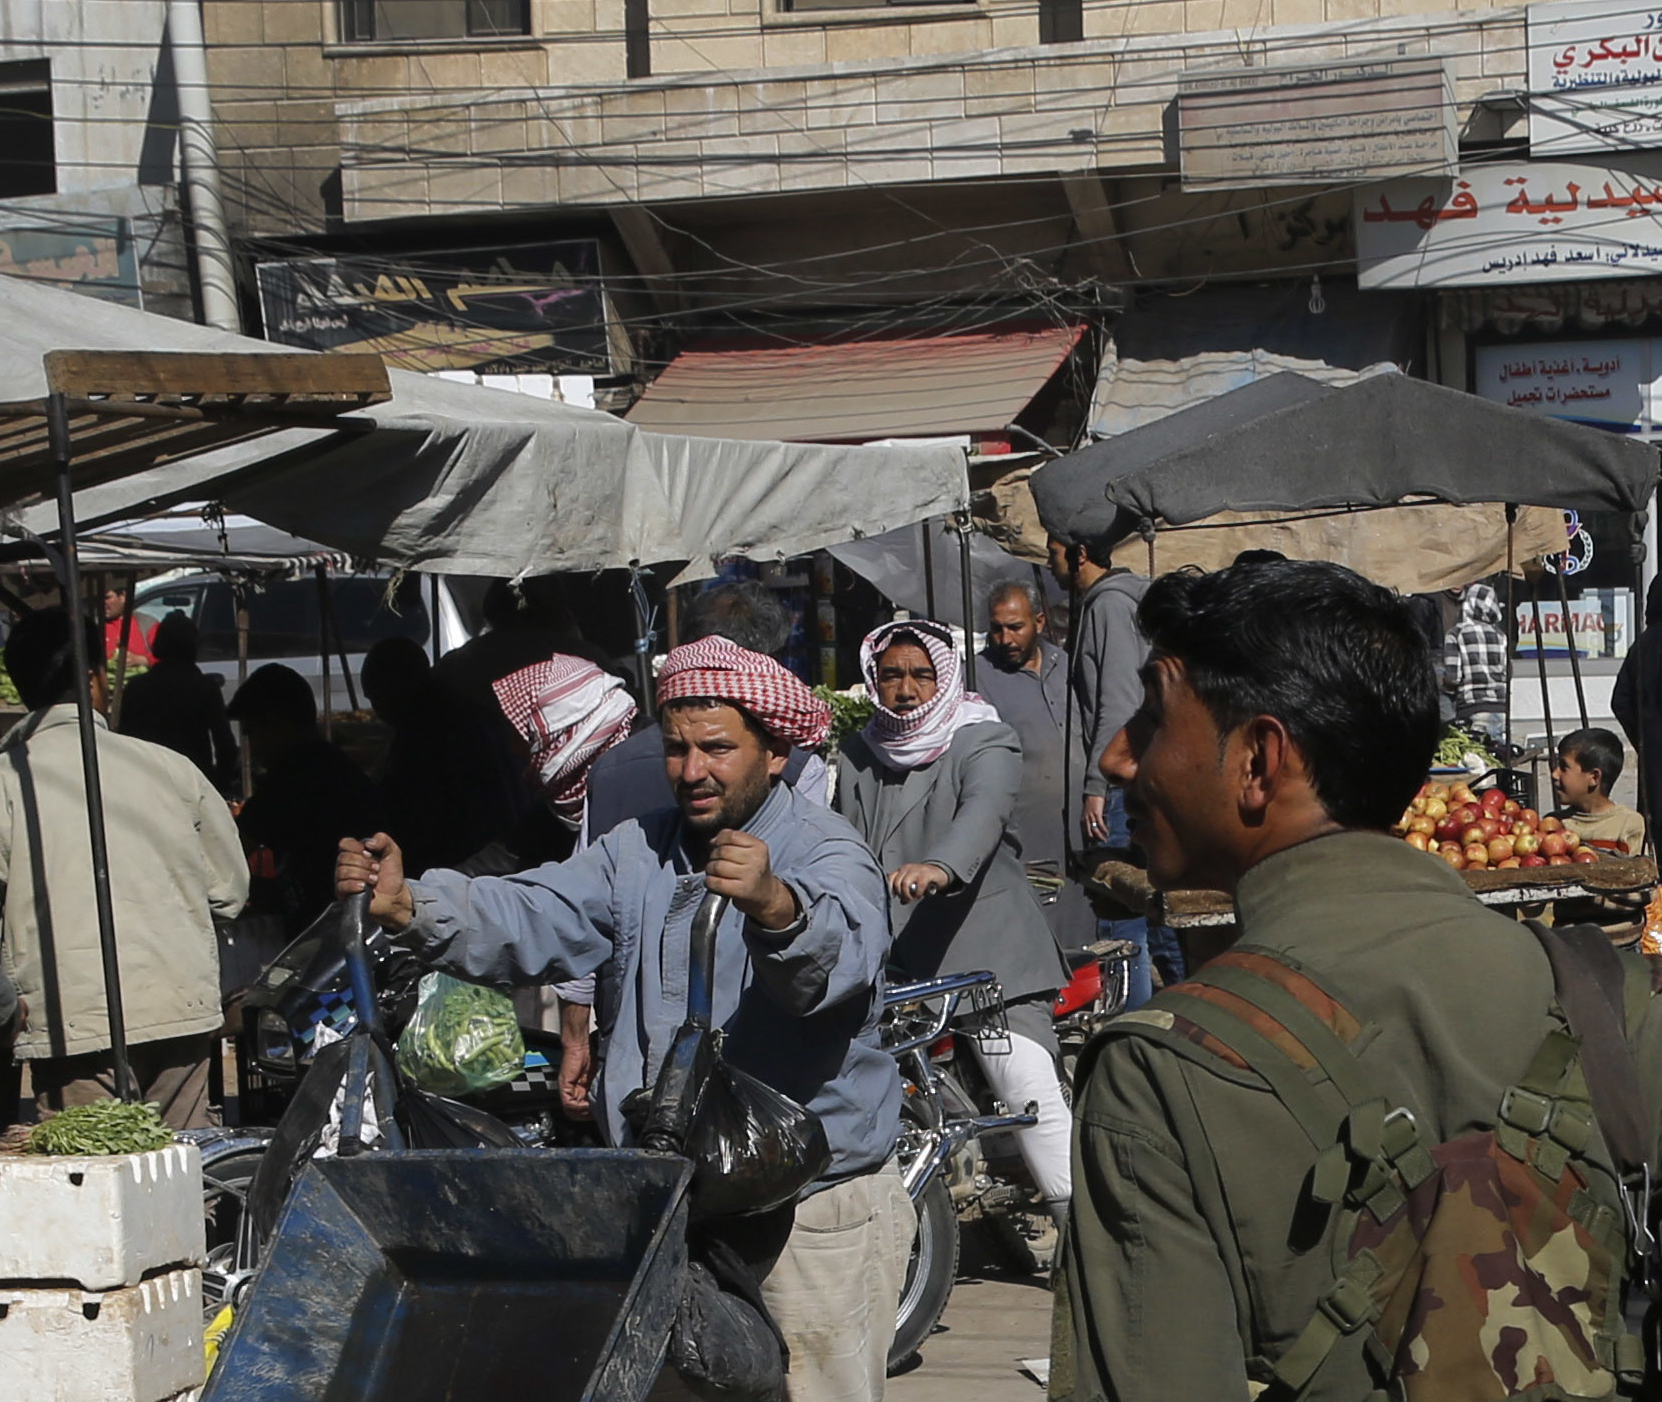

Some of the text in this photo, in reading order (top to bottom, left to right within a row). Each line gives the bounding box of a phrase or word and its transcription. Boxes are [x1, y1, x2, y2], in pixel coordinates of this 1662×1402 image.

[1552, 34, 1650, 75] البكري
[1362, 179, 1479, 230] فهد
[1518, 612, 1606, 634] HARMAC
